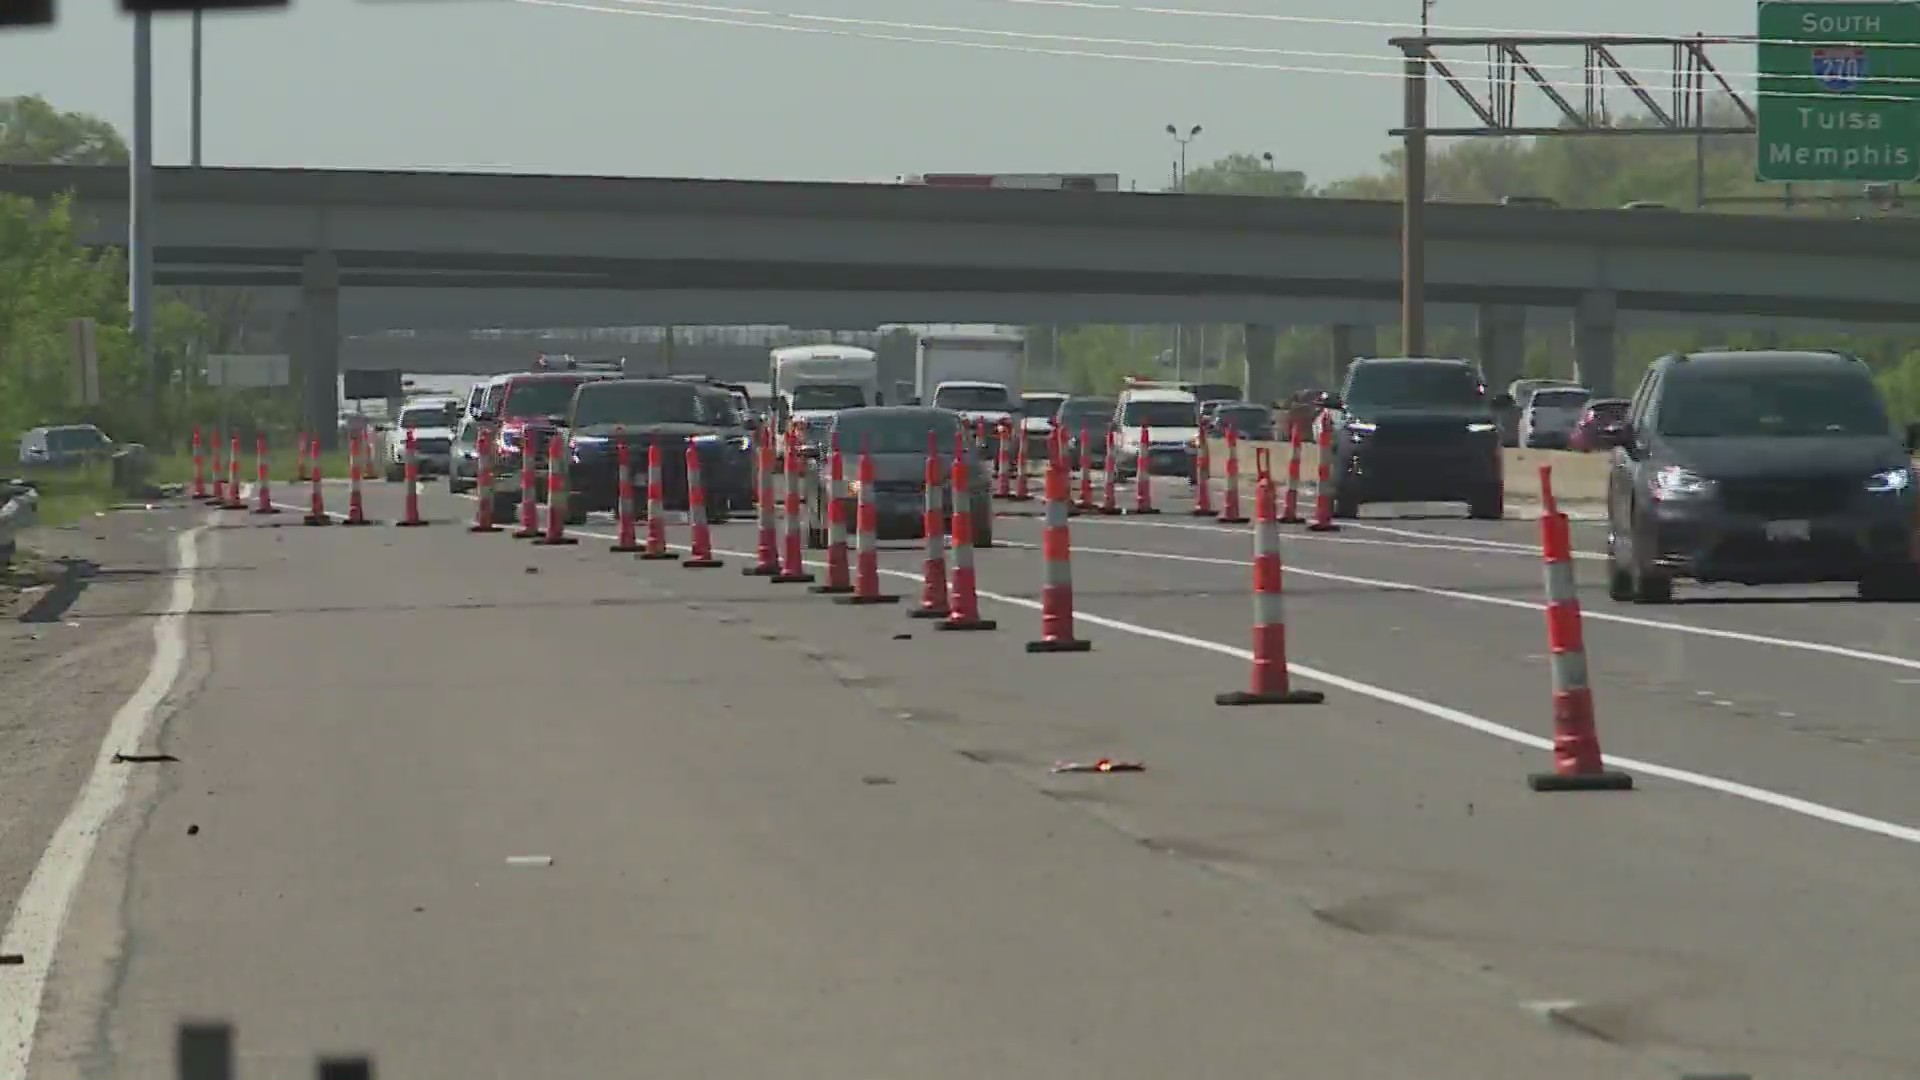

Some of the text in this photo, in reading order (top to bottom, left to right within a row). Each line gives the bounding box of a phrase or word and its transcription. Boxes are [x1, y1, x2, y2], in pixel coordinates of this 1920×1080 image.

[1802, 12, 1880, 32] SOUTH
[1823, 58, 1858, 81] 270
[1797, 107, 1882, 130] Tulsa
[1769, 143, 1909, 168] Memphis
